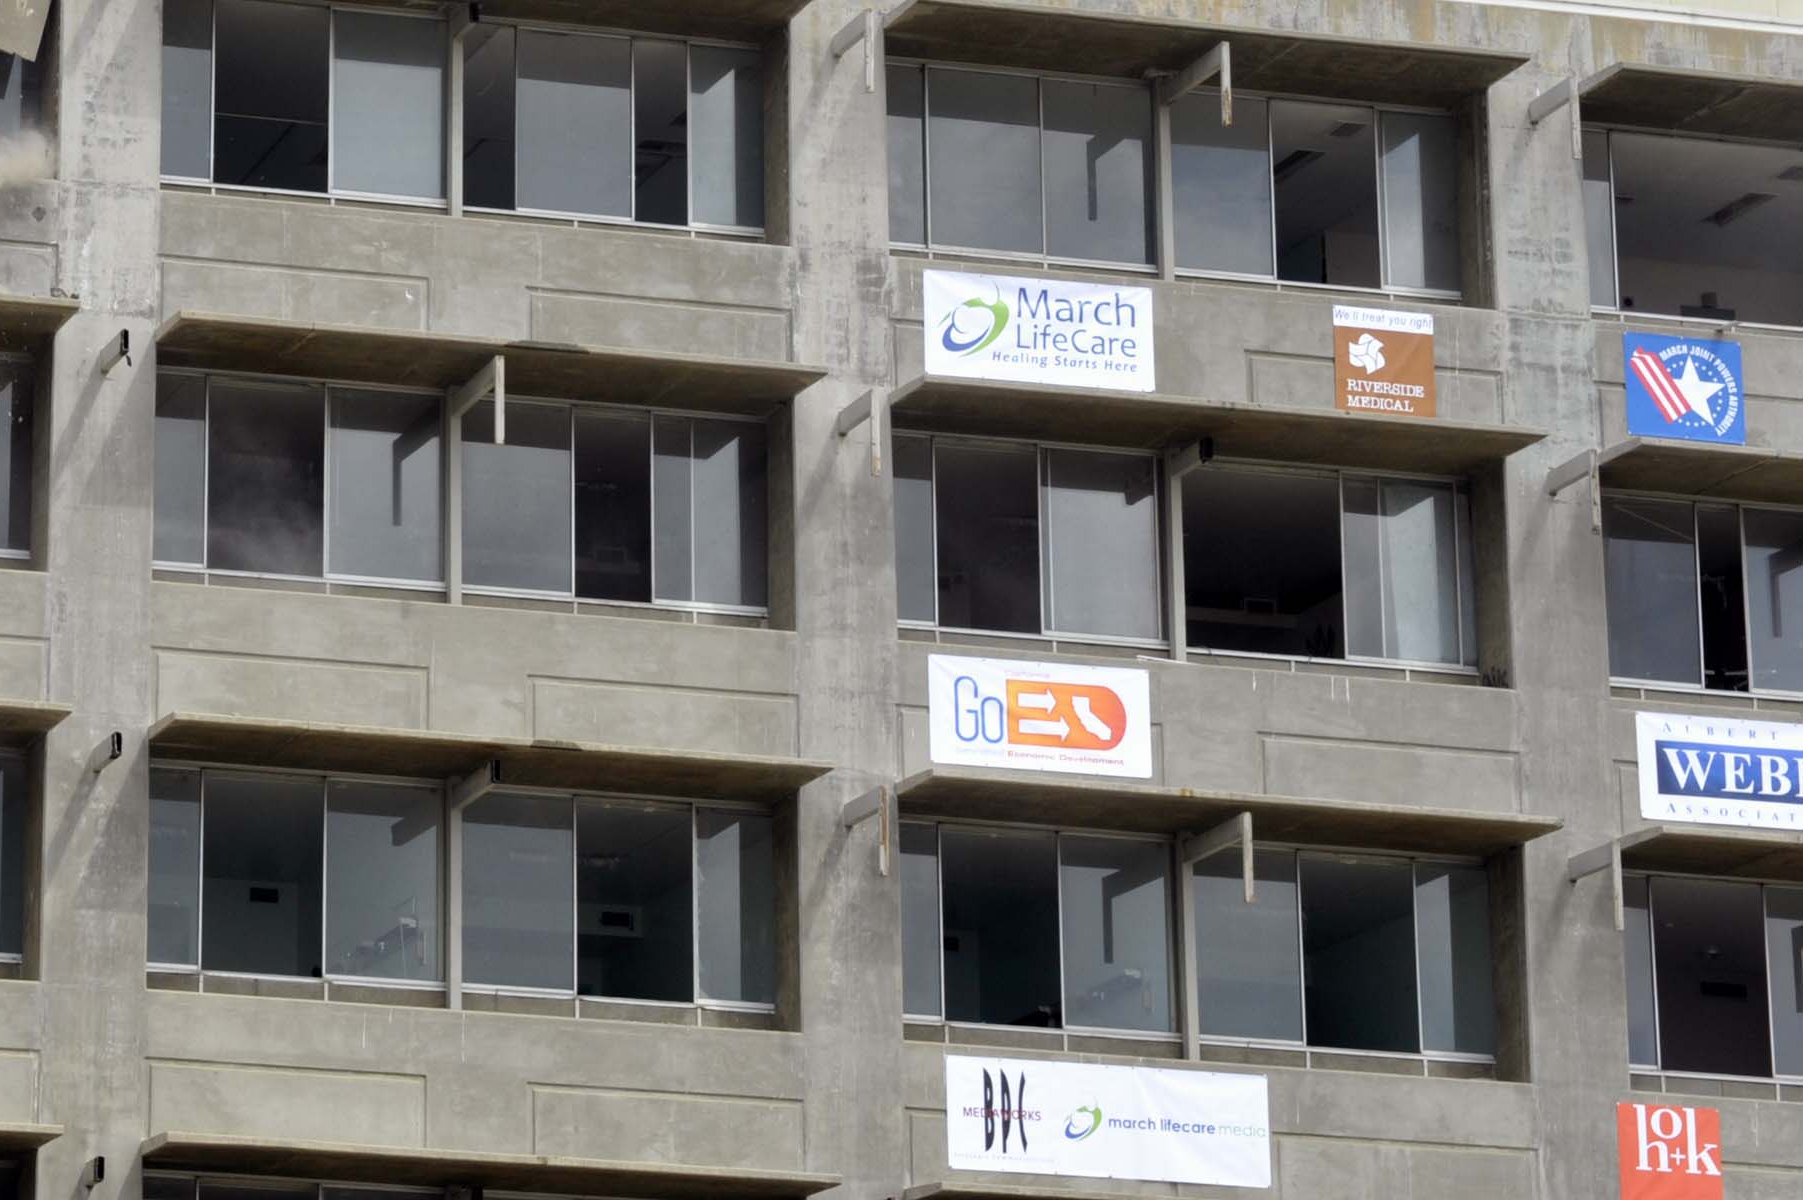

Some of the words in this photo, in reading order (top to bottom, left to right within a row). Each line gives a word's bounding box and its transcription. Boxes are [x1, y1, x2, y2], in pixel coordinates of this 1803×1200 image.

[1017, 287, 1136, 328] March
[1389, 315, 1407, 326] you
[1016, 323, 1137, 358] LifeCare
[992, 351, 1048, 368] Healing
[1054, 356, 1097, 370] Starts
[1104, 360, 1138, 372] Here
[1659, 344, 1688, 361] MARCH
[1689, 345, 1716, 363] JOINT
[1713, 358, 1738, 394] POWERS
[1346, 378, 1425, 398] RIVERSIDE
[1347, 394, 1414, 412] MEDICAL
[1715, 395, 1739, 437] AUTHORITY
[1662, 747, 1803, 798] WEB
[1108, 1117, 1157, 1131] march
[1160, 1118, 1216, 1135] lifecare
[1218, 1124, 1267, 1138] media
